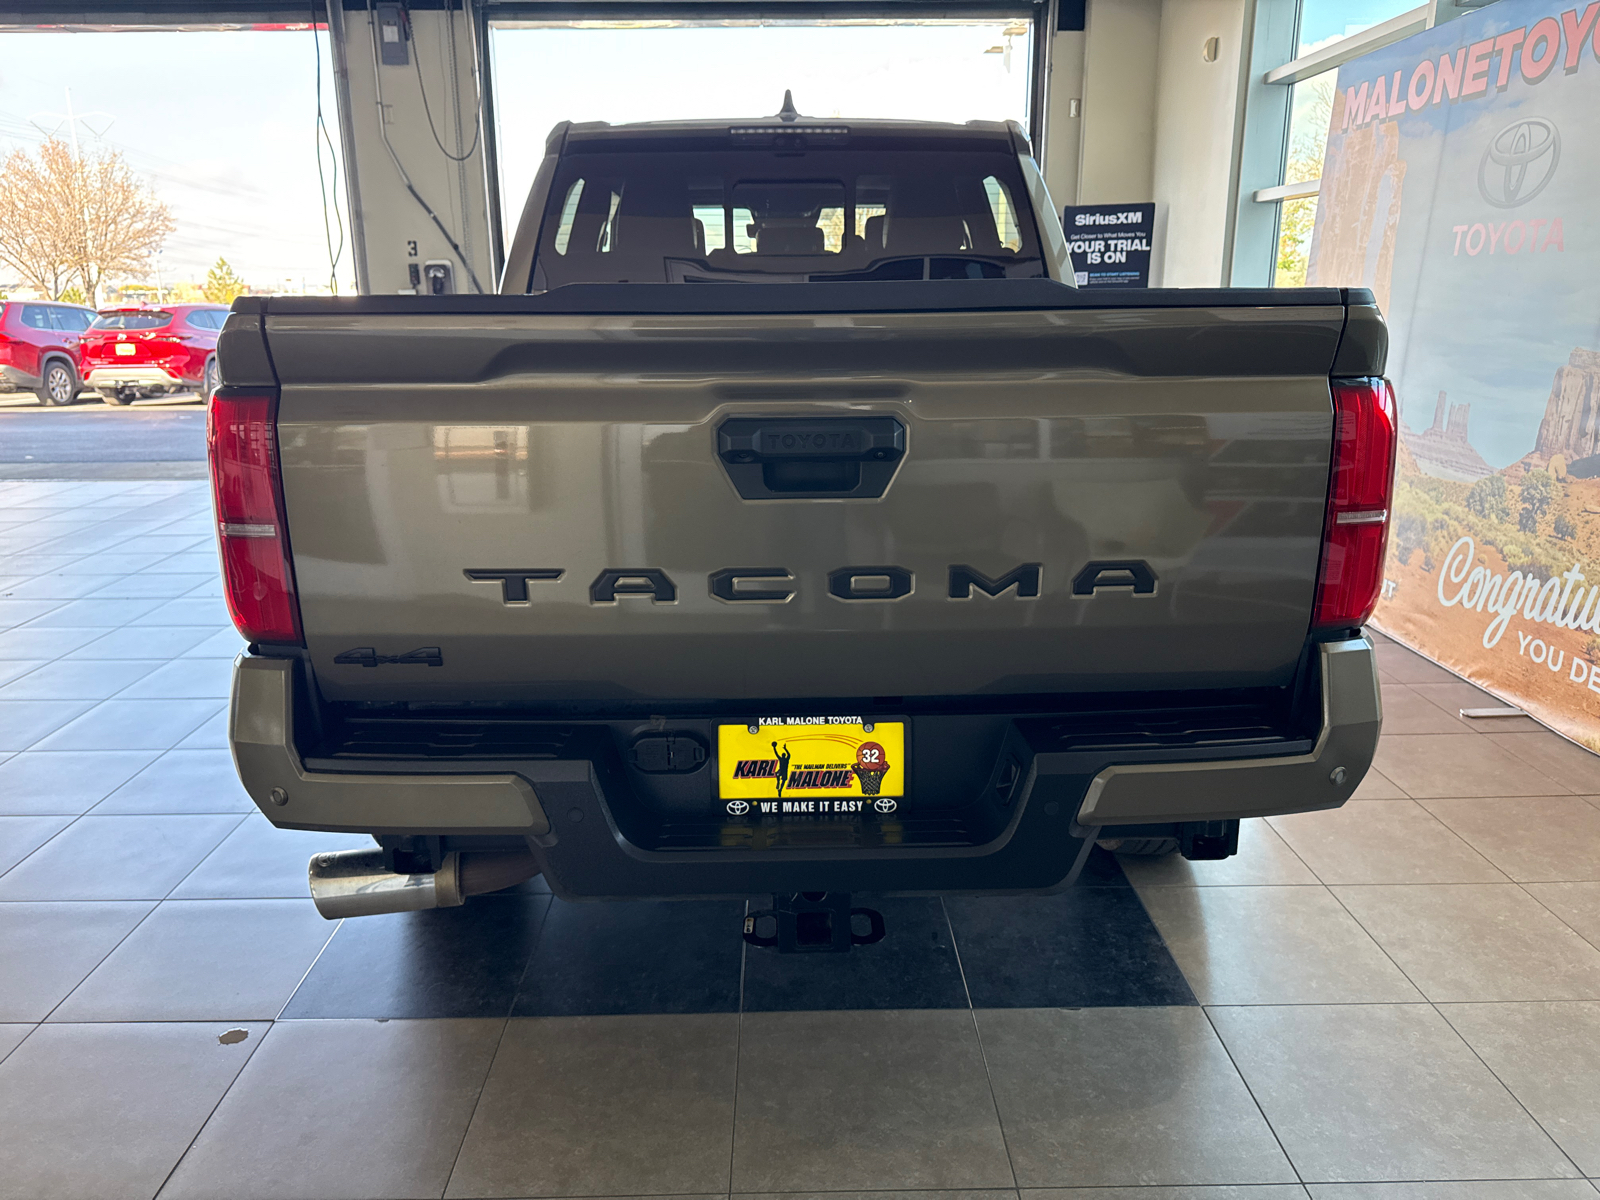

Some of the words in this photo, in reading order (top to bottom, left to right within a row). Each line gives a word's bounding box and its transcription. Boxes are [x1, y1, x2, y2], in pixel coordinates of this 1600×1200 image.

[1341, 0, 1600, 132] MALONETOY
[1075, 211, 1142, 226] SiriusXM
[1452, 217, 1565, 256] TOYOTA
[407, 240, 418, 257] 3
[1066, 240, 1105, 253] YOUR
[1108, 239, 1150, 252] TRIAL
[1087, 252, 1101, 264] IS
[1103, 251, 1126, 263] ON
[768, 433, 855, 449] TOYOTA
[462, 558, 1160, 606] TACOMA
[1437, 536, 1600, 649] Congratu
[1517, 631, 1564, 672] YOU
[758, 717, 784, 726] KARL
[786, 716, 825, 725] MALONE
[827, 716, 863, 724] TOYOTA
[862, 749, 880, 763] 32
[733, 760, 779, 780] KARL
[786, 770, 854, 789] MALONE
[760, 801, 778, 813] WE
[782, 801, 814, 813] MAKE
[819, 801, 829, 812] IT
[834, 801, 863, 812] EASY
